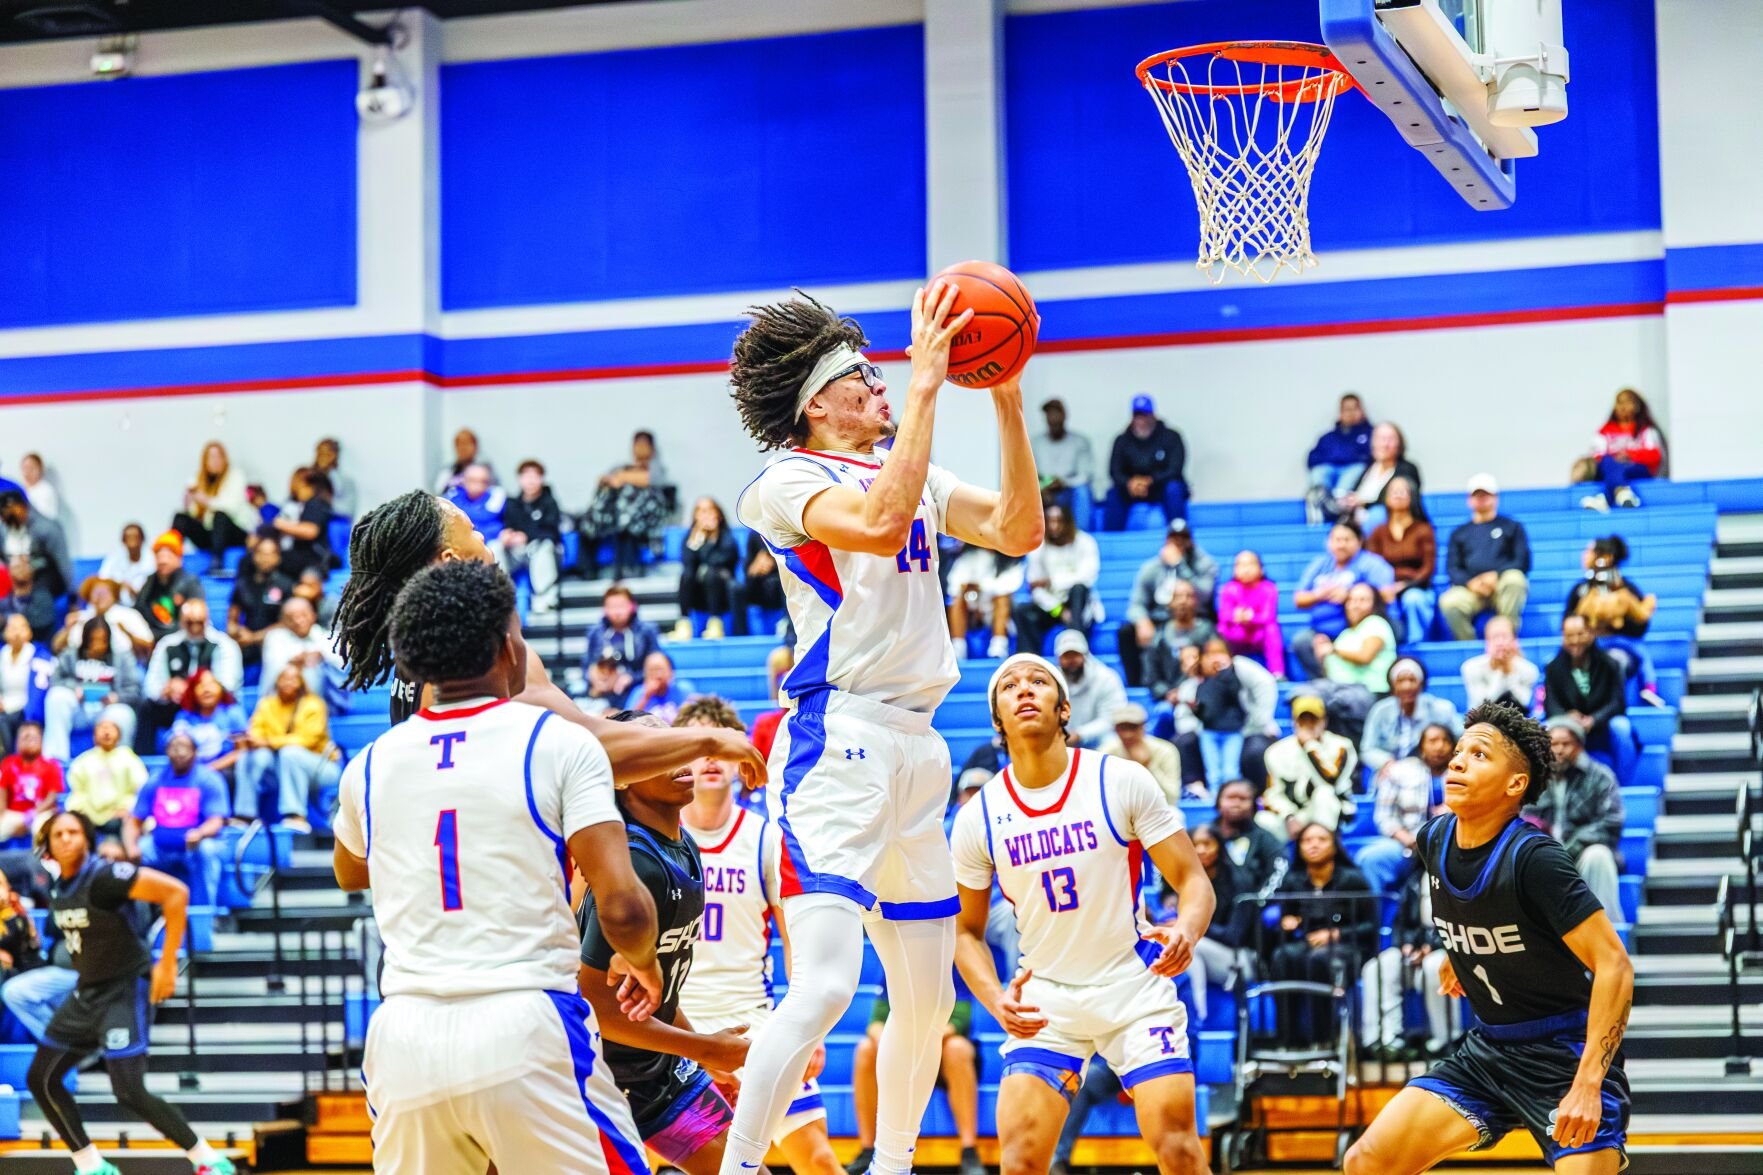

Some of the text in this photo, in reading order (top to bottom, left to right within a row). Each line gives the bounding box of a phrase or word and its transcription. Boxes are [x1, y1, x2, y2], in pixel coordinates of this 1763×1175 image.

[430, 731, 467, 770] T
[434, 809, 464, 912] 1
[1004, 820, 1098, 868] WILDCATS
[705, 866, 746, 894] CATS
[1041, 866, 1079, 912] 13
[656, 911, 704, 954] SHO
[703, 902, 723, 942] 0
[1433, 916, 1526, 955] SHOE
[1473, 964, 1503, 1006] 1
[1149, 1026, 1175, 1054] T
